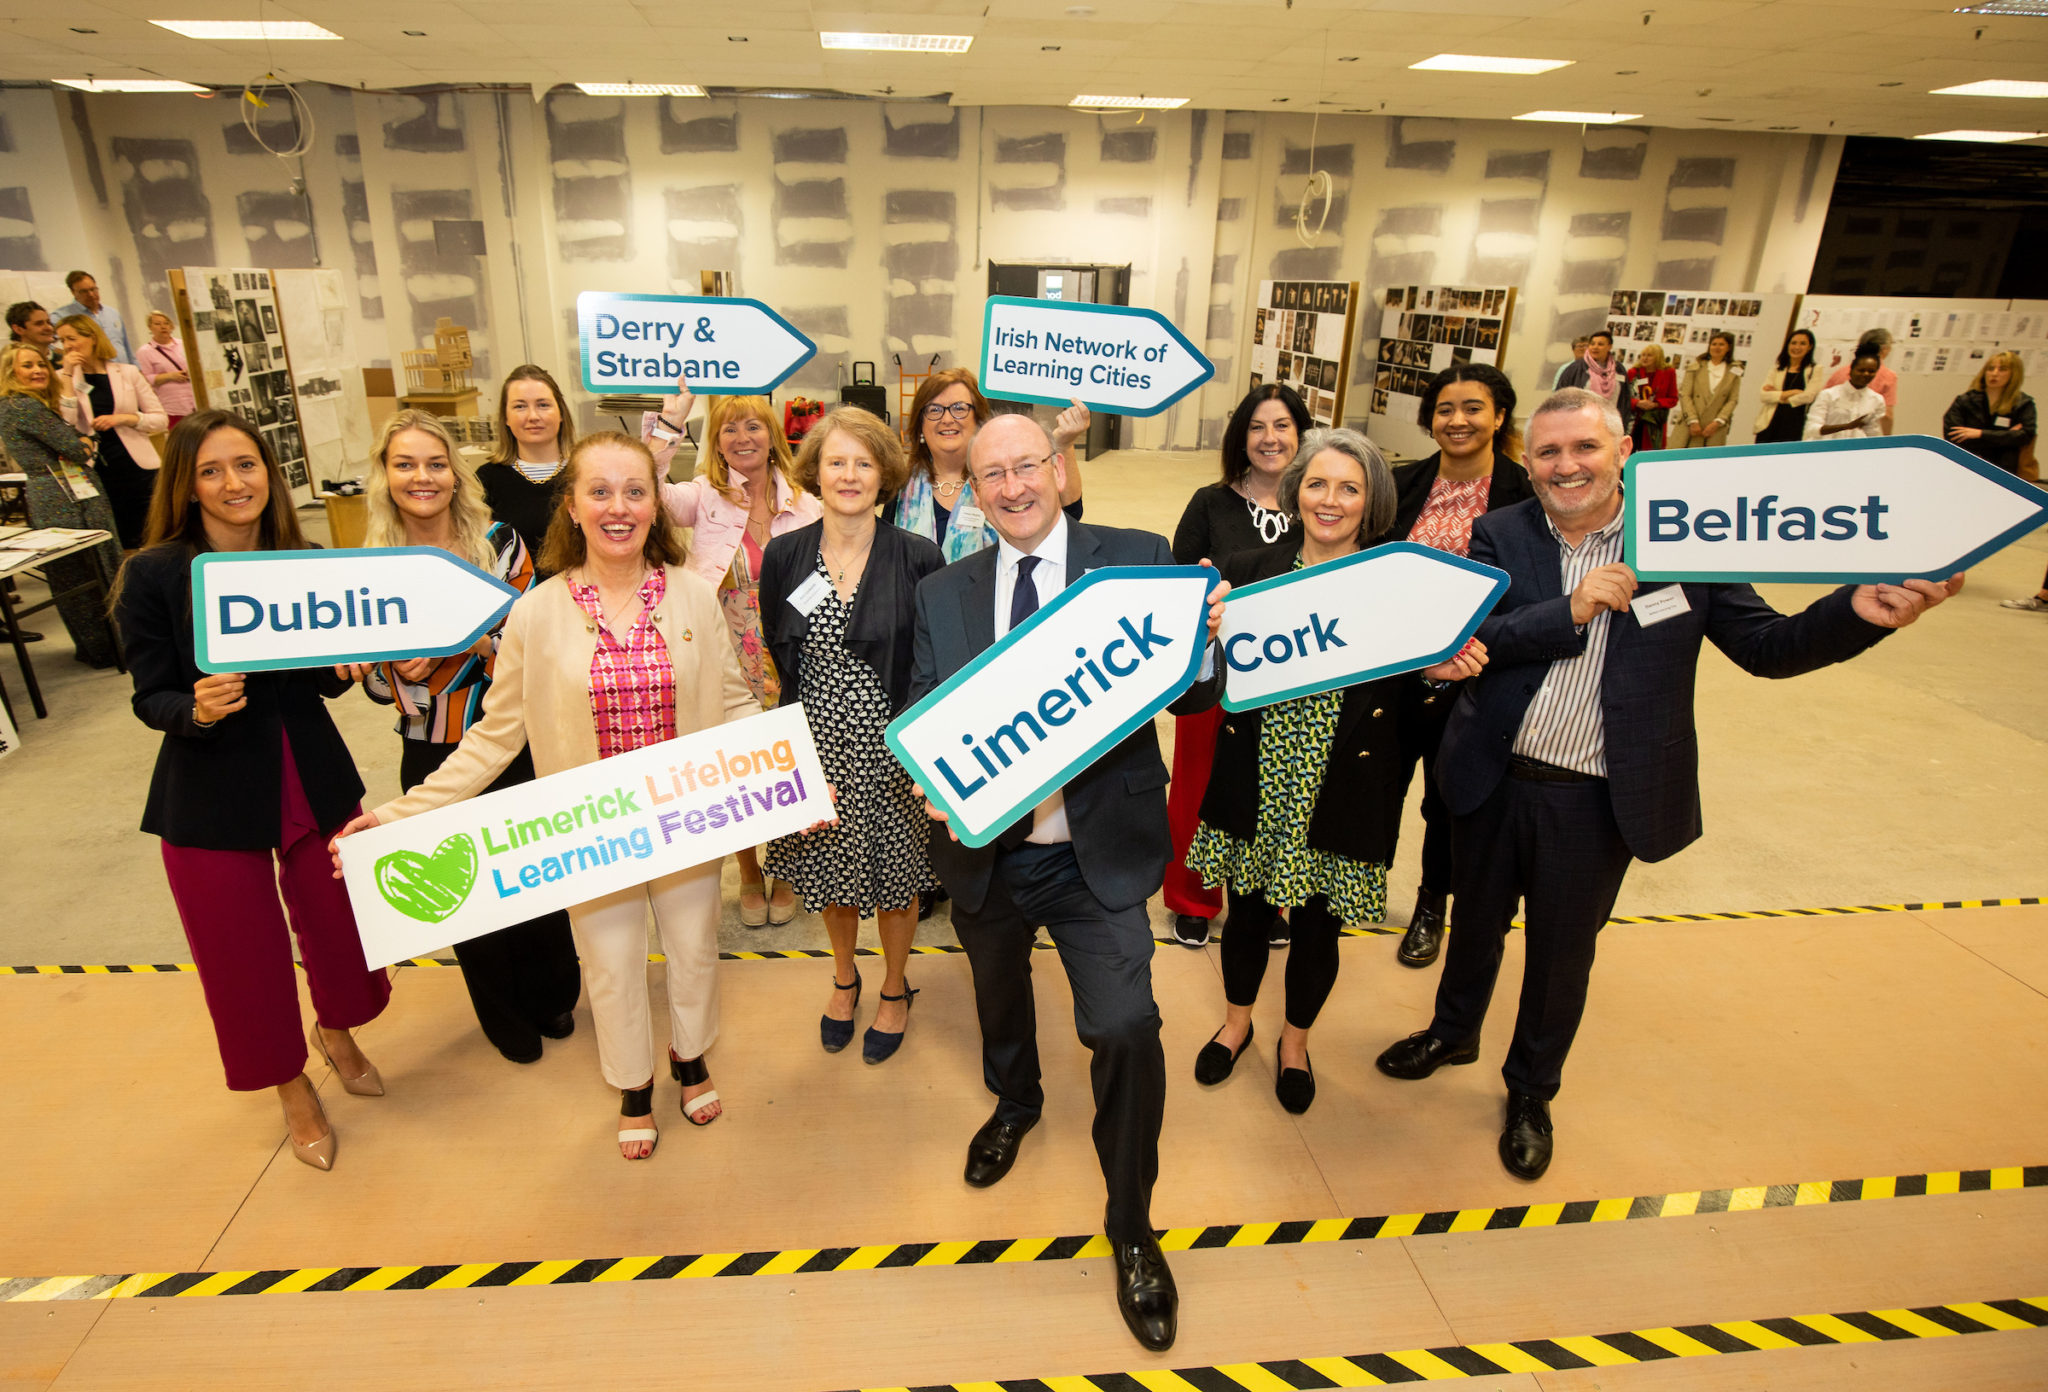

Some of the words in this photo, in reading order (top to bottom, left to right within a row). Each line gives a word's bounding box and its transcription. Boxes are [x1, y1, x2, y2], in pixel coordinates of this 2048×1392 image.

[595, 313, 685, 348] Derry
[693, 316, 716, 343] &
[995, 326, 1038, 349] Irish
[1044, 331, 1138, 361] Network
[1143, 343, 1169, 363] of
[596, 350, 741, 380] Strabane
[992, 353, 1083, 387] Learning
[1089, 364, 1152, 390] Cities
[1648, 494, 1889, 543] Belfast
[218, 586, 409, 635] Dublin
[1224, 612, 1348, 674] Cork
[933, 611, 1174, 802] Limerick
[481, 787, 641, 857] Limerick
[645, 738, 798, 806] Lifelong
[491, 825, 654, 899] Learning
[657, 768, 808, 845] Festival
